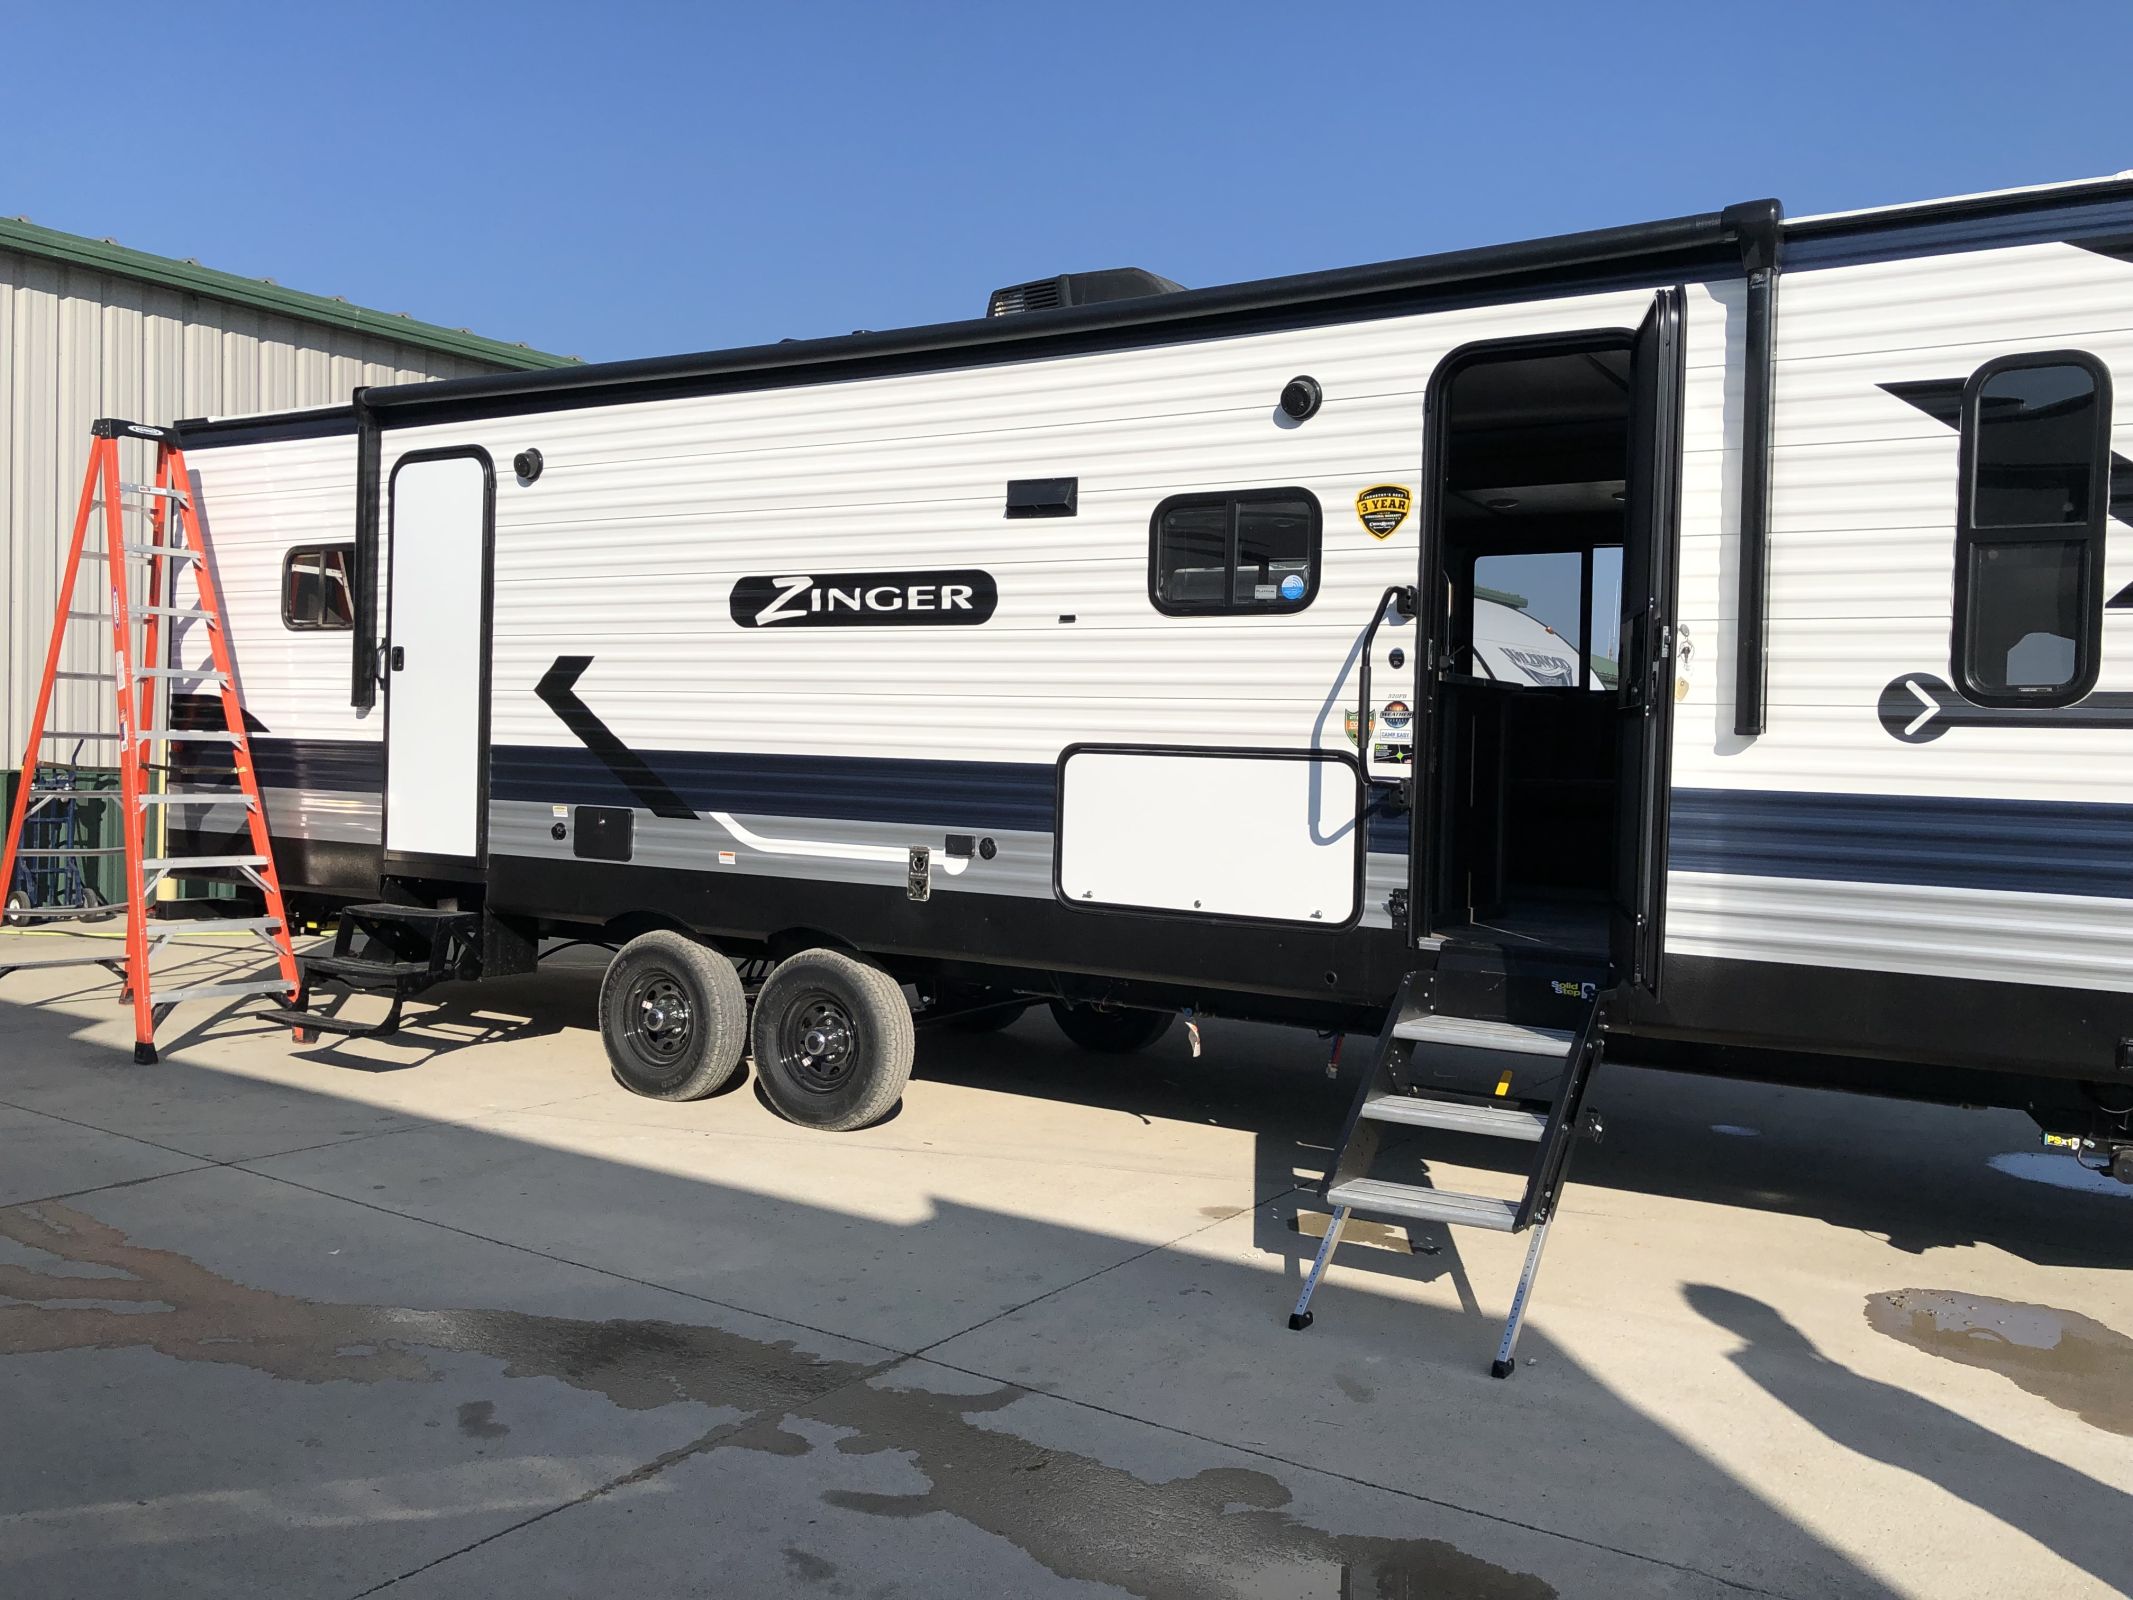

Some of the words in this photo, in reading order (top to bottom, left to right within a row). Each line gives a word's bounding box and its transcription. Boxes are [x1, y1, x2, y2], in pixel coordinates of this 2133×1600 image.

[1361, 502, 1368, 512] 3
[1372, 499, 1406, 510] YEAR
[755, 576, 973, 626] ZINGER
[1551, 980, 1579, 990] Solid
